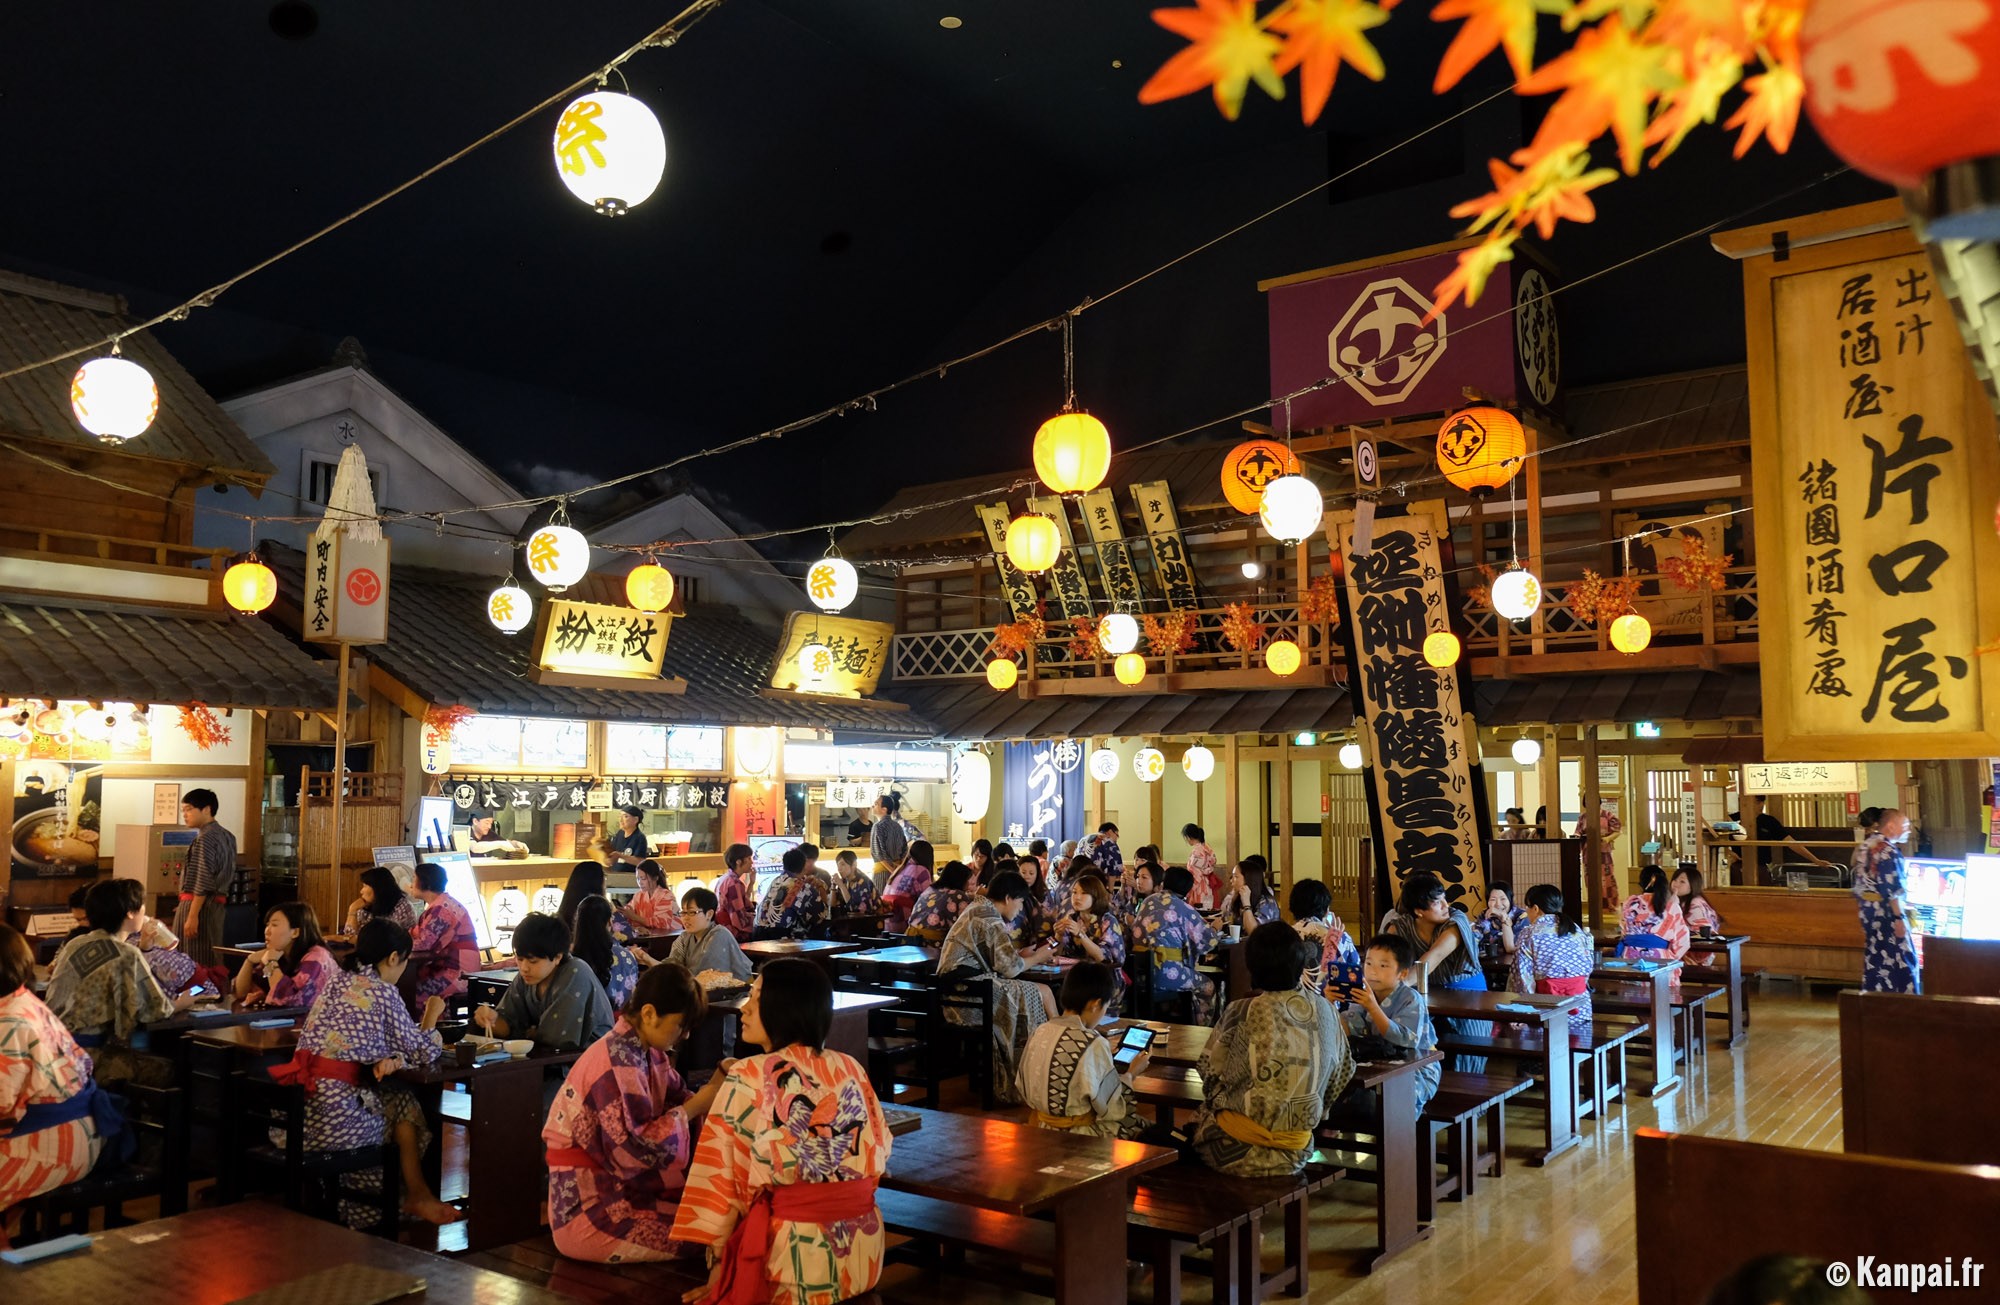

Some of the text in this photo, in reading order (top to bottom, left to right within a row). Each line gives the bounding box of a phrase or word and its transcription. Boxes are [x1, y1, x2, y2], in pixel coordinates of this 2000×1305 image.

[553, 100, 608, 177] 祭
[1895, 268, 1932, 355] 出汁
[1836, 273, 1895, 420] 居酒屋
[338, 422, 355, 440] 水
[529, 532, 560, 573] 祭
[1860, 413, 1969, 724] 片口屋
[311, 540, 331, 632] 町内安全
[810, 564, 837, 599] 祭
[490, 592, 514, 622] 祭
[595, 616, 627, 630] 大江戸
[555, 608, 658, 663] 粉 紋
[598, 631, 618, 642] 鉄板
[813, 650, 831, 674] 祭
[863, 636, 884, 678] うどん
[426, 733, 441, 771] 生ビール
[1776, 766, 1829, 780] 返却処
[484, 786, 587, 808] 大江戸鉄
[616, 784, 727, 807] 板厨房粉紋
